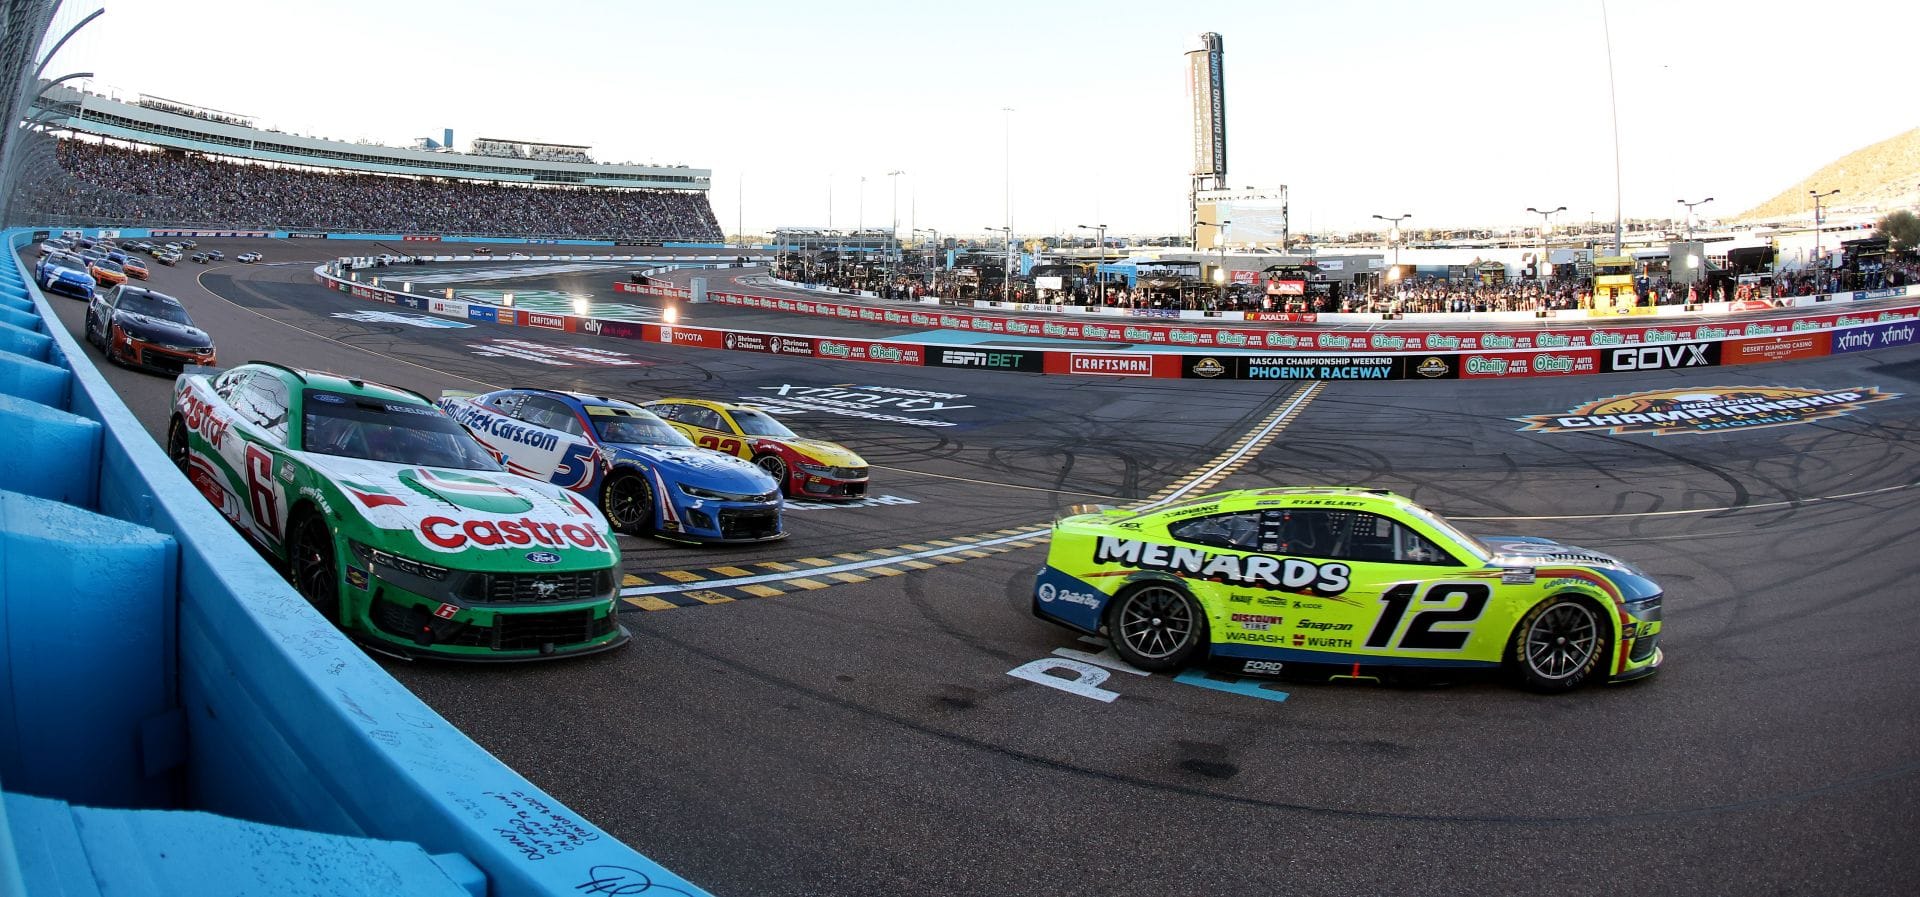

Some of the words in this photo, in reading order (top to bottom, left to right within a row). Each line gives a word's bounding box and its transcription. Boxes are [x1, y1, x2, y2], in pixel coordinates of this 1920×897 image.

[1213, 89, 1221, 136] DIAMOND
[1215, 137, 1223, 172] DESERT
[1521, 252, 1538, 280] 3
[530, 315, 562, 328] CRAFTSMAN
[584, 320, 602, 335] ally
[674, 331, 703, 342] TOYOTA
[737, 335, 762, 344] Shriners
[782, 339, 809, 347] Shriners
[1838, 330, 1875, 351] xfinity
[1881, 325, 1915, 345] xfinity
[737, 342, 764, 350] Children's
[782, 346, 811, 354] Children's
[819, 341, 850, 359] O'Reilly
[869, 343, 902, 362] O'Reilly
[1742, 345, 1764, 353] DESERT
[1765, 343, 1791, 351] DIAMOND
[942, 350, 987, 366] ESPN
[988, 353, 1023, 368] BET
[1076, 358, 1146, 371] CRAFTSMAN
[1286, 358, 1350, 366] CHAMPIONSHIP
[1353, 357, 1393, 365] WEEKEND
[1533, 354, 1575, 373] O'Reilly
[1612, 344, 1709, 370] GOVX
[1249, 367, 1316, 378] PHOENIX
[1320, 367, 1391, 378] RACEWAY
[1466, 355, 1508, 376] O'Reilly
[1574, 363, 1593, 371] PARTS
[1558, 392, 1863, 428] CHAMPIONSHIP
[1680, 397, 1765, 410] NASCAR
[1653, 408, 1817, 427] WEEKEND
[1696, 415, 1799, 430] PHOENIX
[550, 443, 599, 492] 5
[246, 442, 281, 545] 6
[420, 516, 608, 550] Castrol
[1096, 535, 1350, 593] MENARDS
[1231, 613, 1284, 625] DISCOUNT
[1363, 581, 1493, 650] 12
[1296, 619, 1354, 632] Snap-on
[1226, 632, 1285, 644] WABASH
[1244, 661, 1283, 671] FORD
